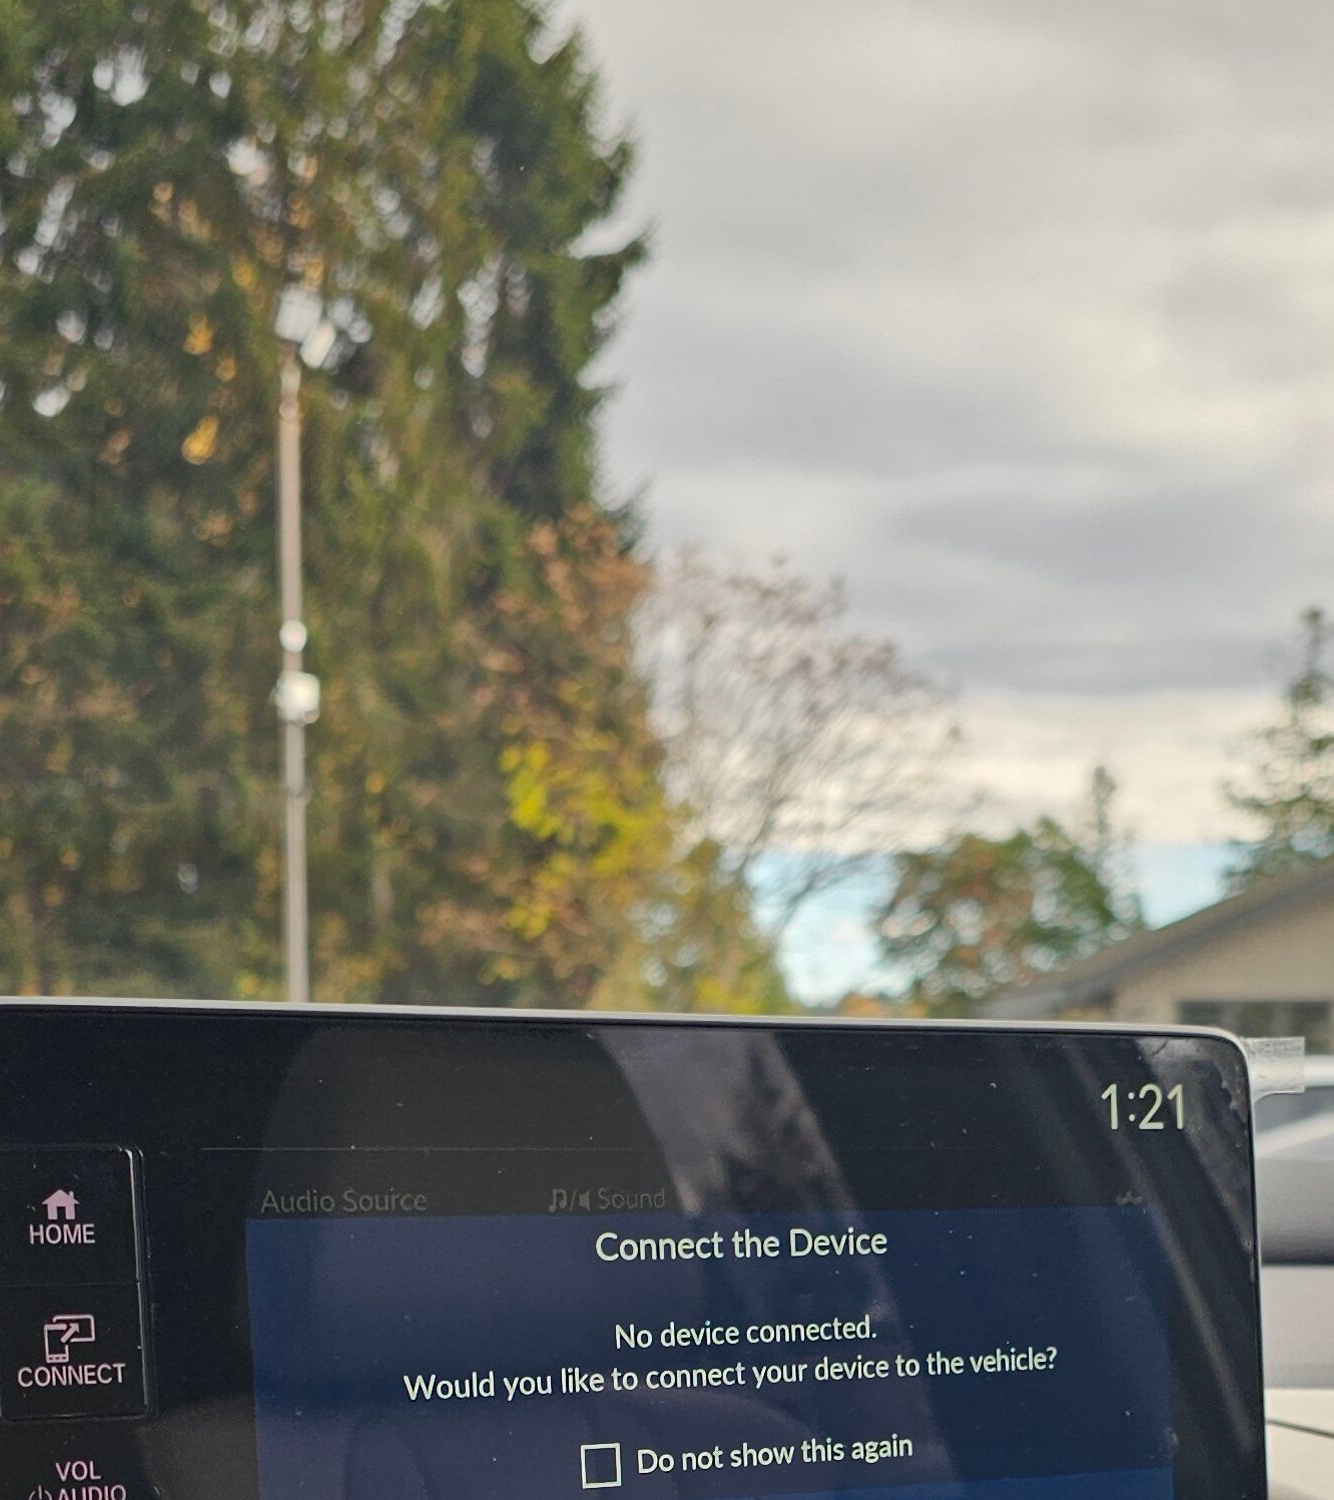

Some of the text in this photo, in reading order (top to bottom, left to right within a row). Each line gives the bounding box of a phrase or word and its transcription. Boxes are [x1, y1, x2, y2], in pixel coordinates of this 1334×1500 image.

[1101, 1083, 1185, 1130] 1:21
[260, 1187, 428, 1213] Audio Source
[597, 1187, 666, 1210] Sound
[28, 1223, 96, 1246] HOME
[595, 1227, 888, 1262] Connect the Device
[614, 1315, 878, 1350] No device connected.
[17, 1362, 127, 1388] CONNECT
[403, 1345, 1057, 1402] Would you like to connect your device to the vehicle?
[637, 1435, 914, 1473] Do not show this again
[54, 1461, 102, 1483] VOL
